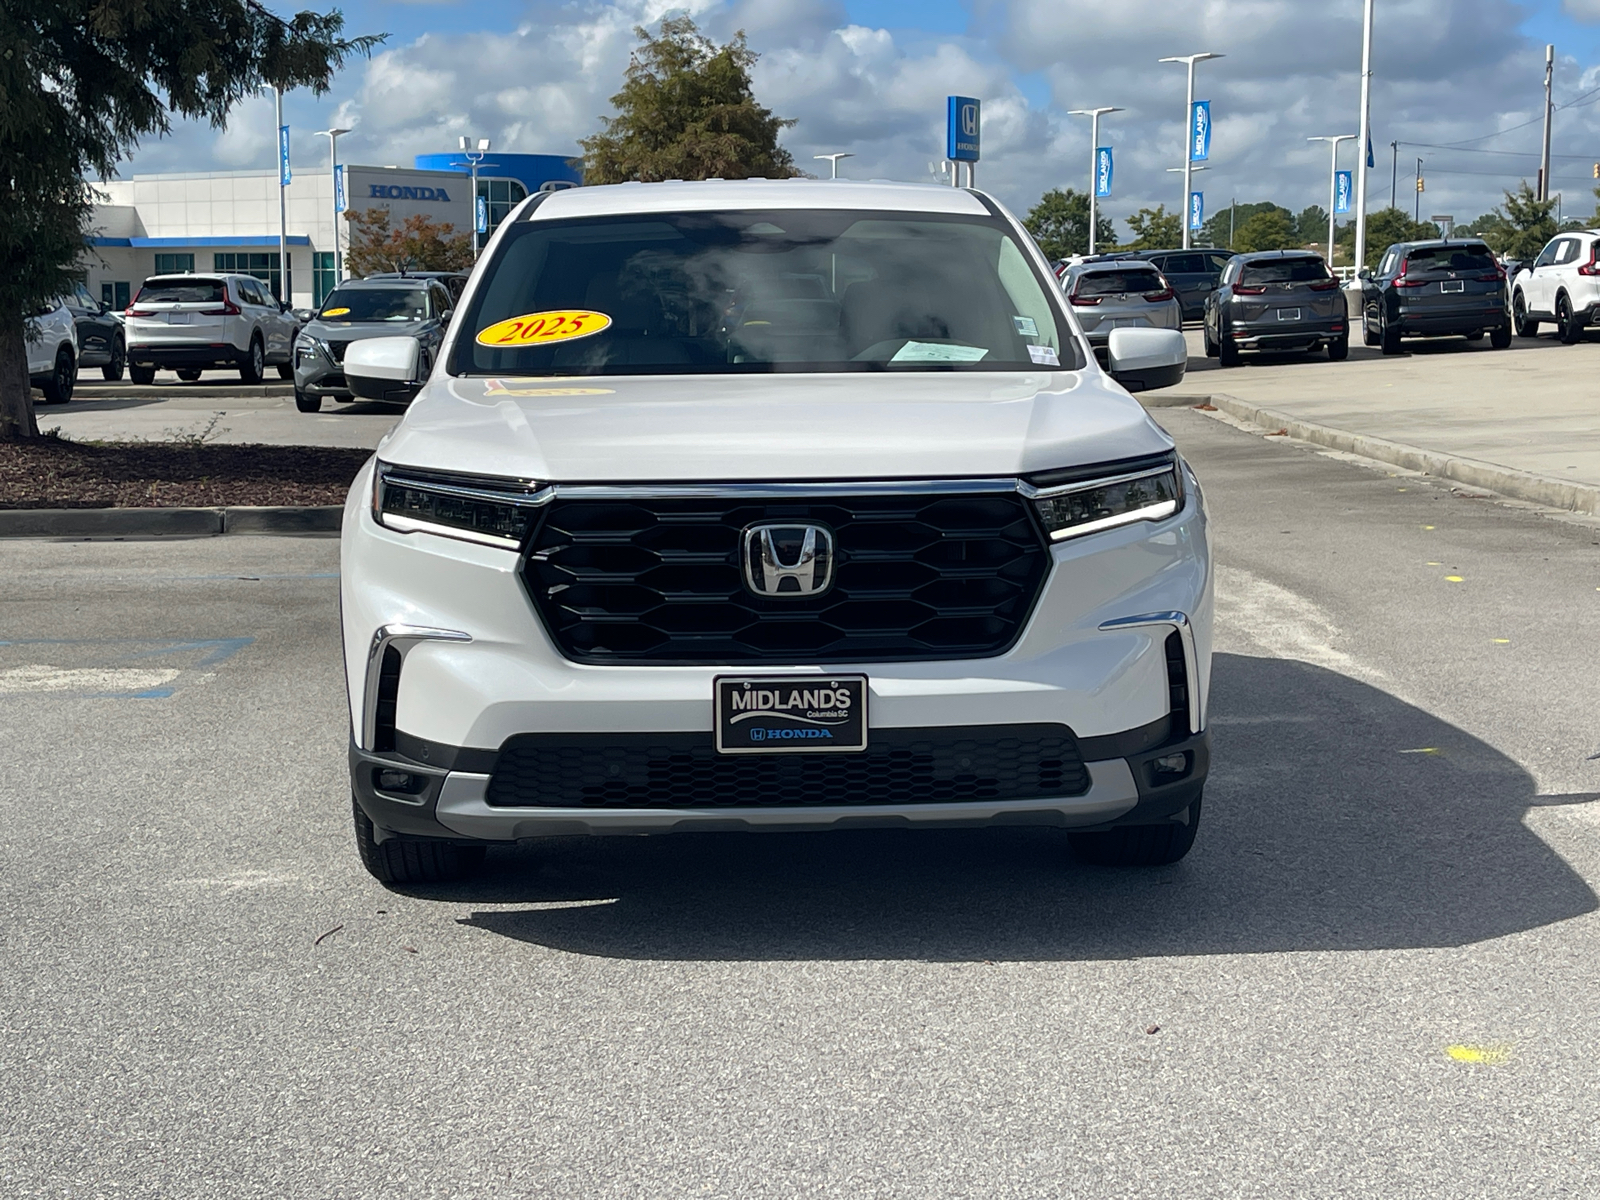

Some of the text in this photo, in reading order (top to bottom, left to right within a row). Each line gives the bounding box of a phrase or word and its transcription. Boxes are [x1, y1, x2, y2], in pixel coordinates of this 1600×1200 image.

[1195, 105, 1203, 155] MIDLANDS
[369, 184, 451, 201] HONDA
[496, 315, 591, 343] 2025
[731, 689, 851, 710] MIDLANDS
[806, 710, 849, 718] Columbia SC
[767, 729, 833, 739] HONDA
